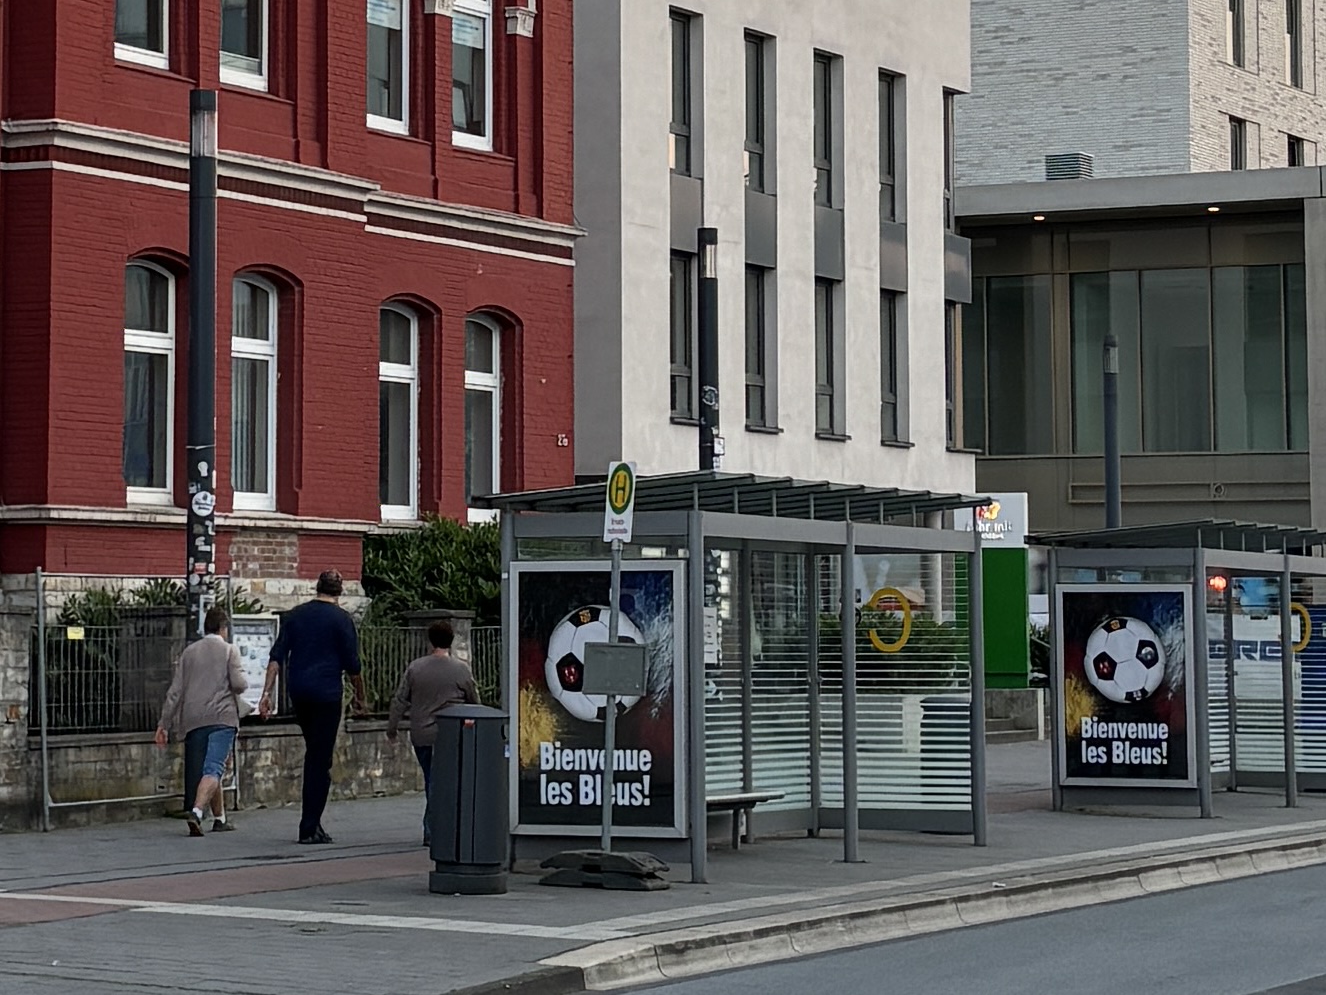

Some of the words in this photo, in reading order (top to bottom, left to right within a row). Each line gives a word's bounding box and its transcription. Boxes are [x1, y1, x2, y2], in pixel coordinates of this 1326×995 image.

[614, 474, 627, 504] H
[1081, 716, 1169, 740] Bienvenue
[1081, 740, 1108, 764] les
[1112, 741, 1168, 765] Bleus!
[540, 773, 573, 806] les
[579, 774, 651, 806] Blus!
